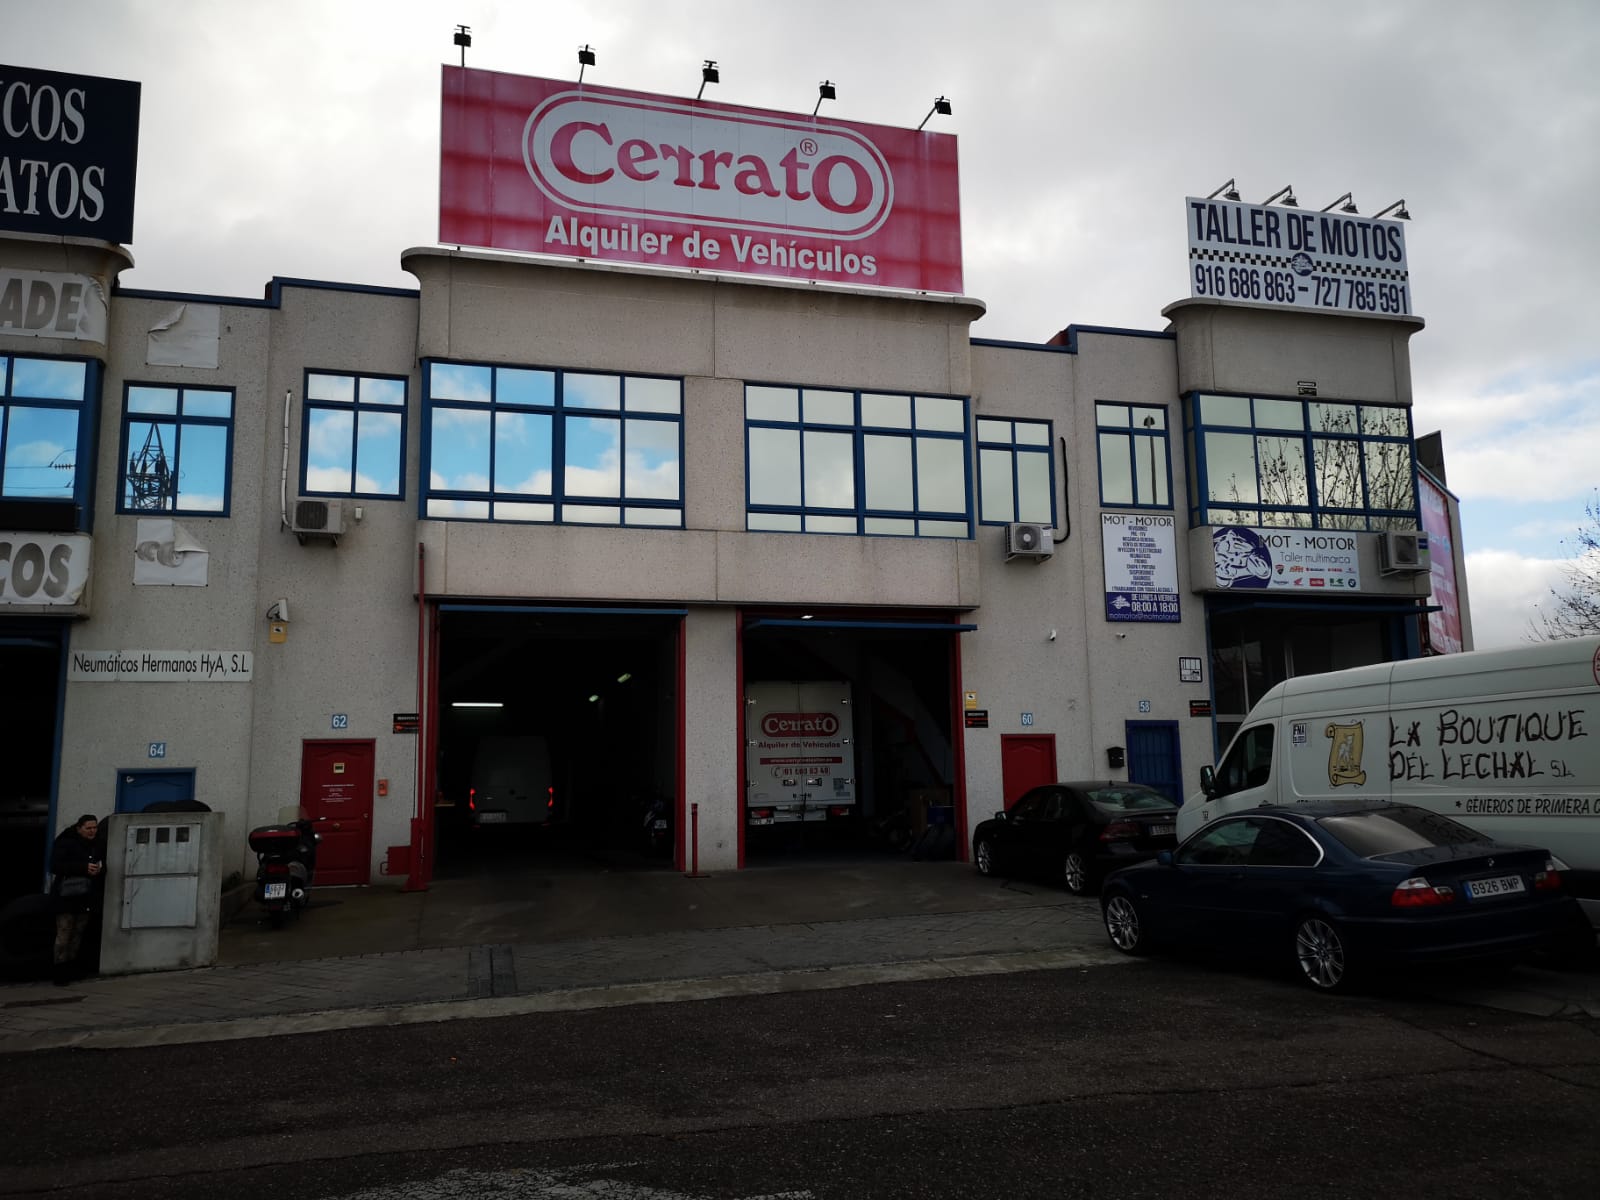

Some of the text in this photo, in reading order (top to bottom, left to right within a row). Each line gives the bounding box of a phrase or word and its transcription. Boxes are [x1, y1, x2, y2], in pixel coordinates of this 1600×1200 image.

[0, 81, 86, 145] COS
[1191, 202, 1402, 263] TALLER DE MOTOS
[544, 216, 877, 277] Alquiler de Vehículos
[1195, 264, 1226, 297] 916
[1229, 267, 1260, 300] 686
[1264, 270, 1295, 304] 863
[1311, 276, 1341, 308] 727
[1345, 279, 1376, 312] 785
[1380, 283, 1408, 315] 591
[0, 278, 90, 333] ADE
[1104, 515, 1127, 525] MOT
[1136, 517, 1172, 527] MOTOR
[1258, 534, 1291, 548] MOT
[1304, 536, 1356, 550] MOTOR
[1279, 552, 1303, 563] Taller
[73, 653, 138, 673] Neumáticos
[142, 653, 197, 673] Hermanos
[231, 654, 249, 673] S.L.
[332, 715, 346, 728] 62
[1022, 713, 1032, 725] 60
[1437, 709, 1588, 747] BOUTIQUE
[150, 743, 164, 757] 64
[1441, 748, 1544, 781] LECHAL
[1517, 798, 1531, 814] DE
[1535, 798, 1589, 815] PRIMERA
[1471, 880, 1499, 896] 6926
